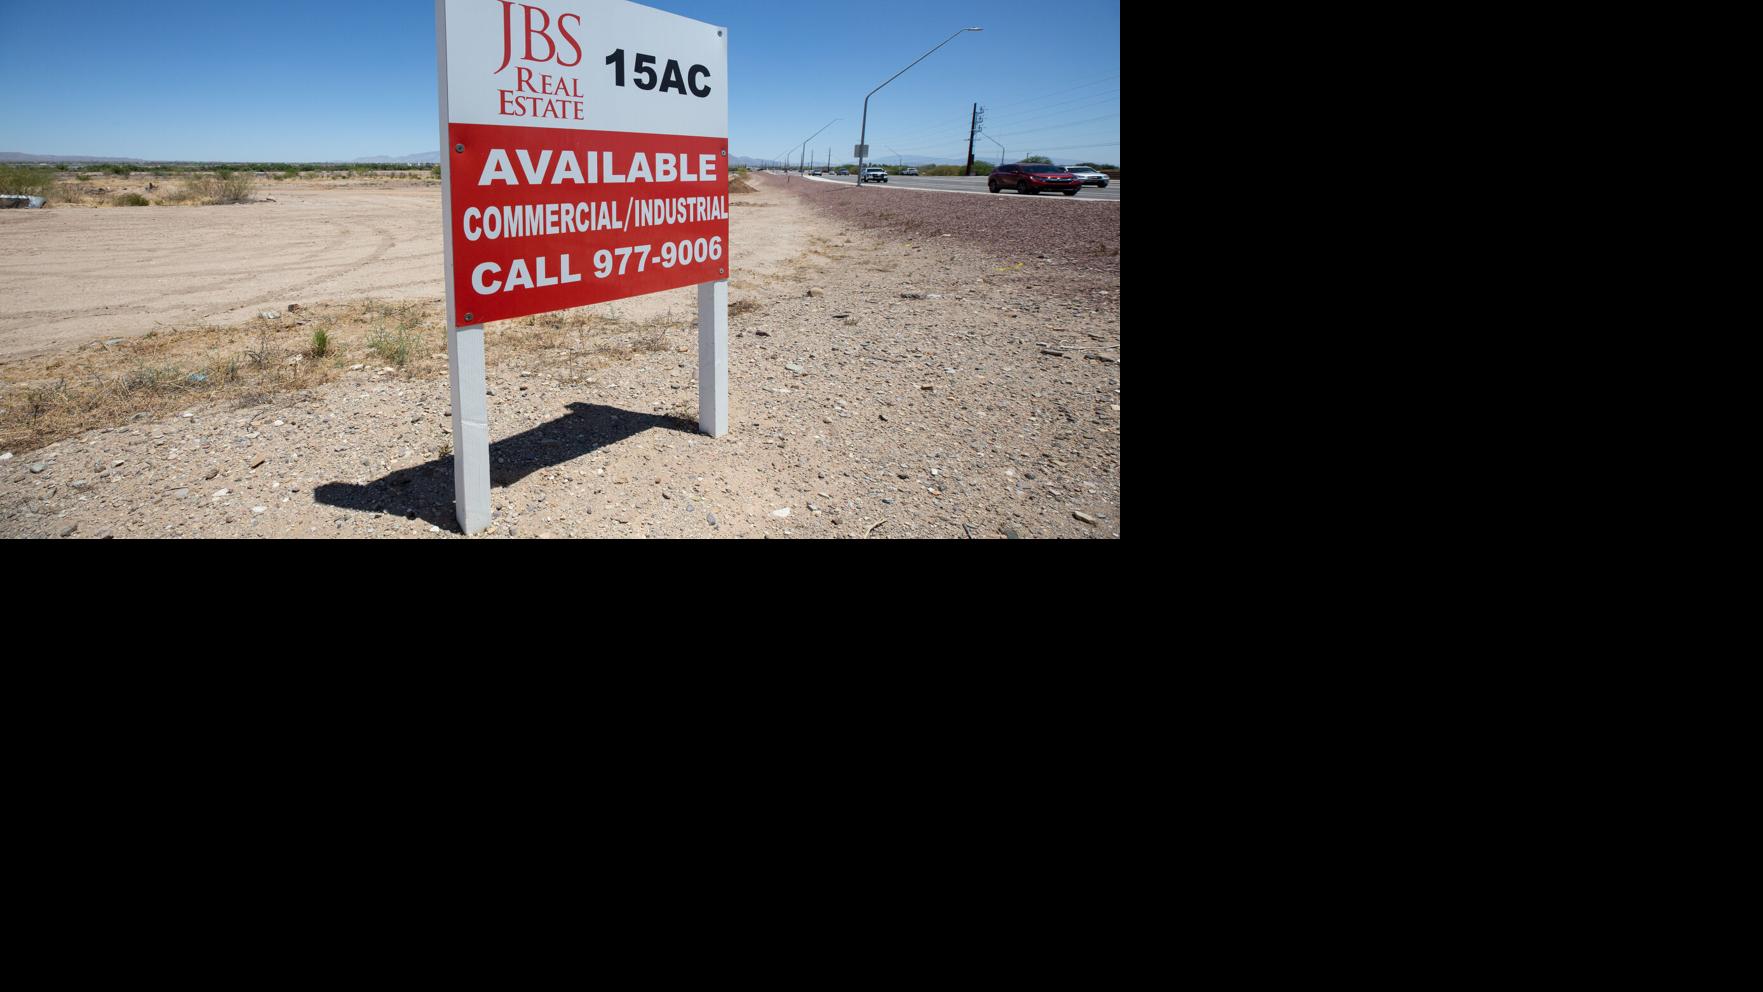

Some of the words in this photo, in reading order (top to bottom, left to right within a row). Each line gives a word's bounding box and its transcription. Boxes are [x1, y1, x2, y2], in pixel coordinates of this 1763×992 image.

[494, 0, 582, 74] JBS
[605, 48, 712, 98] 15AC
[497, 89, 584, 120] ESTATE
[478, 149, 717, 186] AVAILABLE
[463, 196, 728, 241] COMMERCIAL/INDUSTRIAL
[471, 254, 581, 295] CALL
[593, 236, 722, 278] 977-9006
